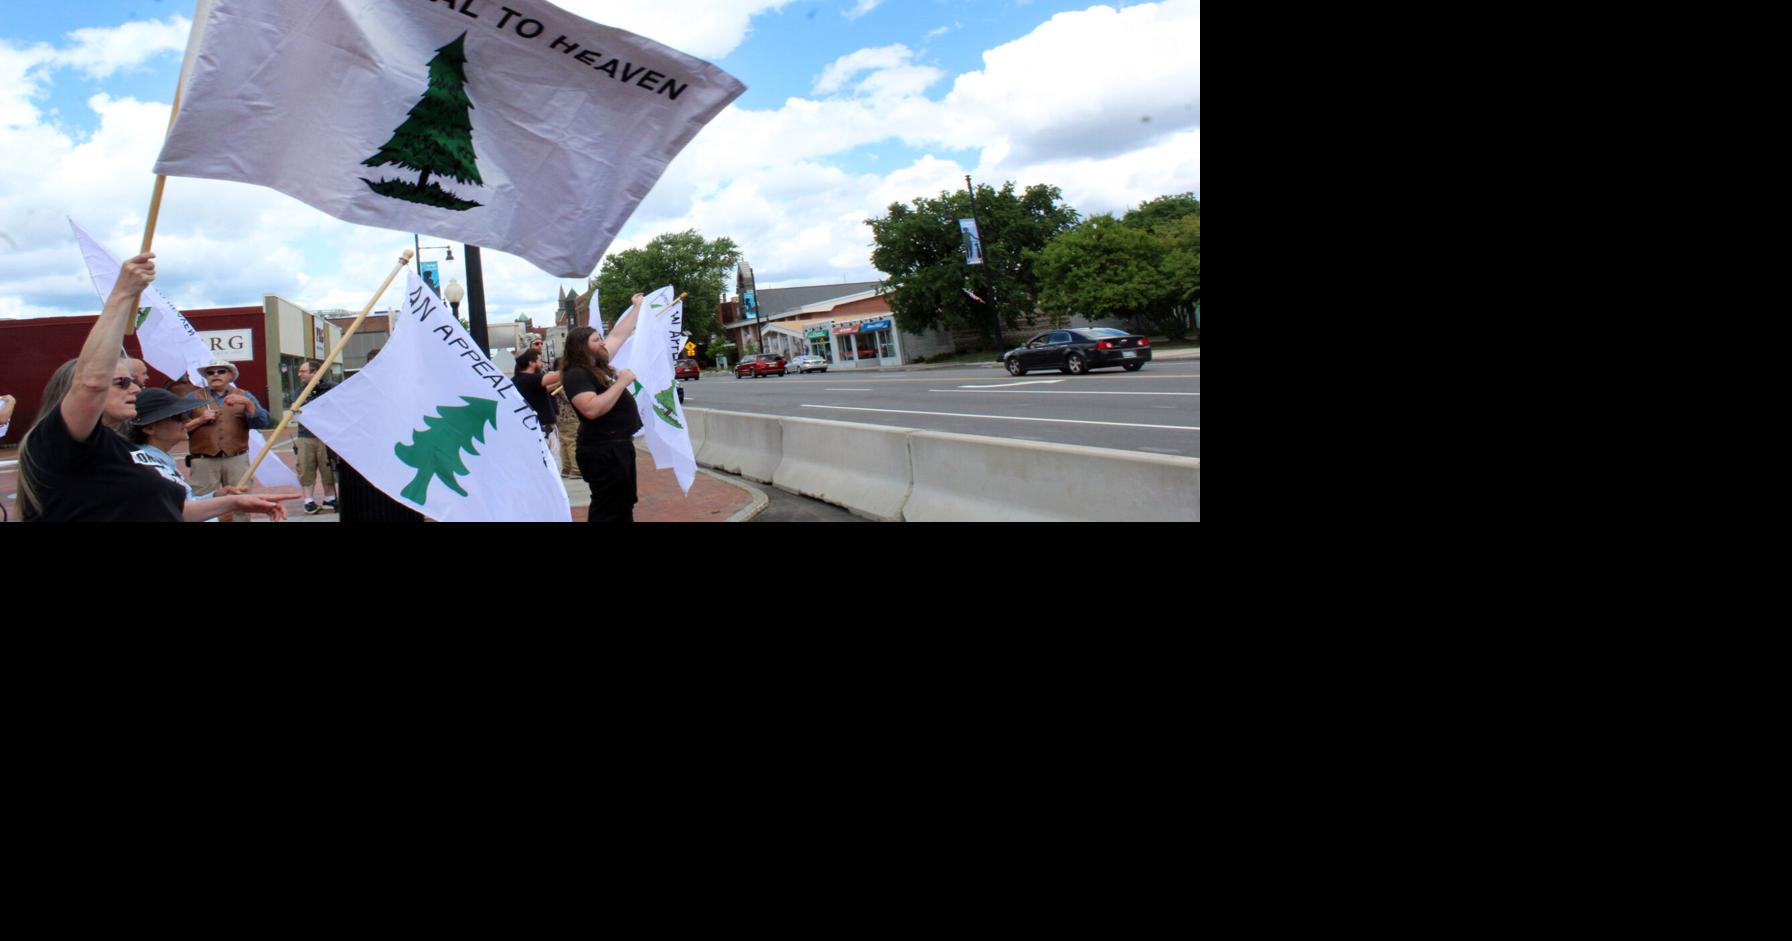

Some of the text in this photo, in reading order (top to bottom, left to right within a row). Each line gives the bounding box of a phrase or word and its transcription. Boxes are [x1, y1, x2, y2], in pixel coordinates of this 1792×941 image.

[496, 6, 544, 38] TO
[550, 35, 688, 100] HEAVEN
[433, 324, 514, 399] APPEAL
